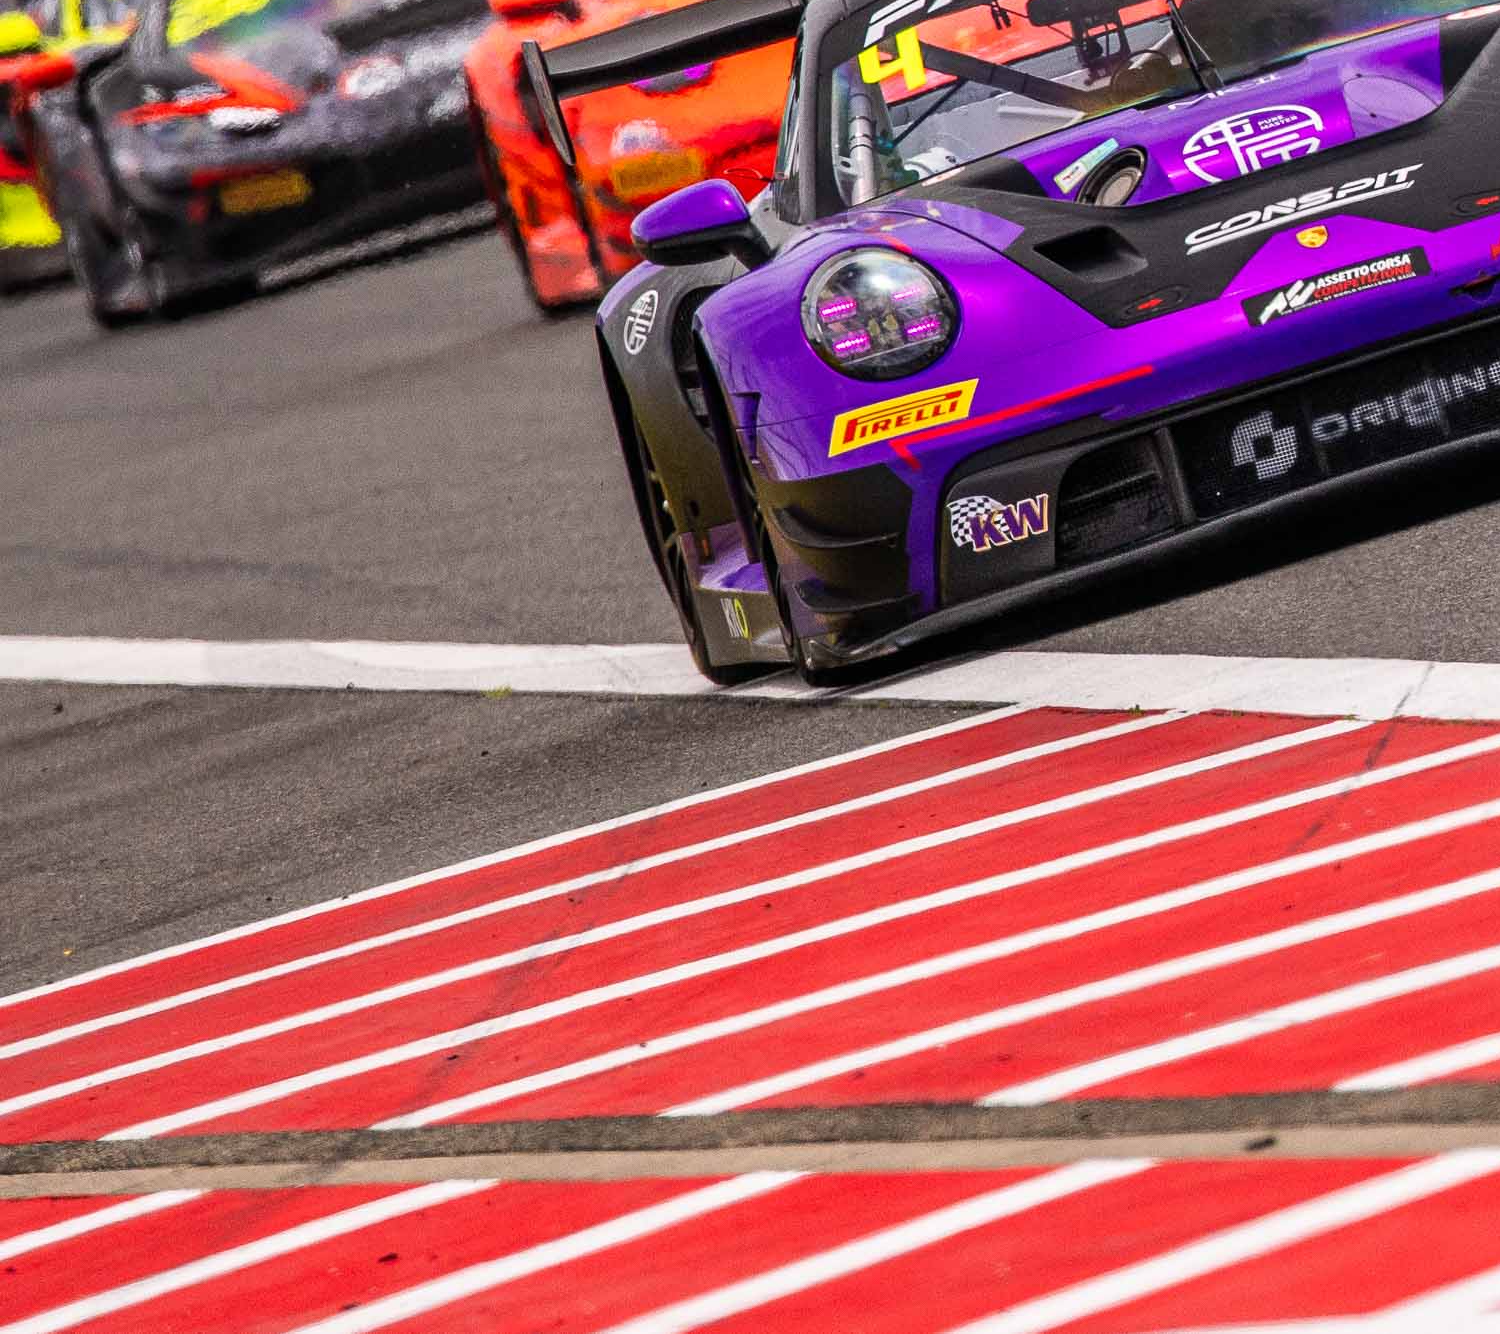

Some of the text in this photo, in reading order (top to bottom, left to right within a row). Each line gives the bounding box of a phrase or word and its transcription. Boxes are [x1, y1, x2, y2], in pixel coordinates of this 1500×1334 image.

[858, 25, 928, 91] 4
[1258, 115, 1299, 132] MASTER
[1184, 164, 1423, 246] CONSPIT
[1315, 252, 1412, 289] ASSETTO CORSA
[843, 389, 962, 445] PIRELLI
[969, 493, 1049, 552] KW
